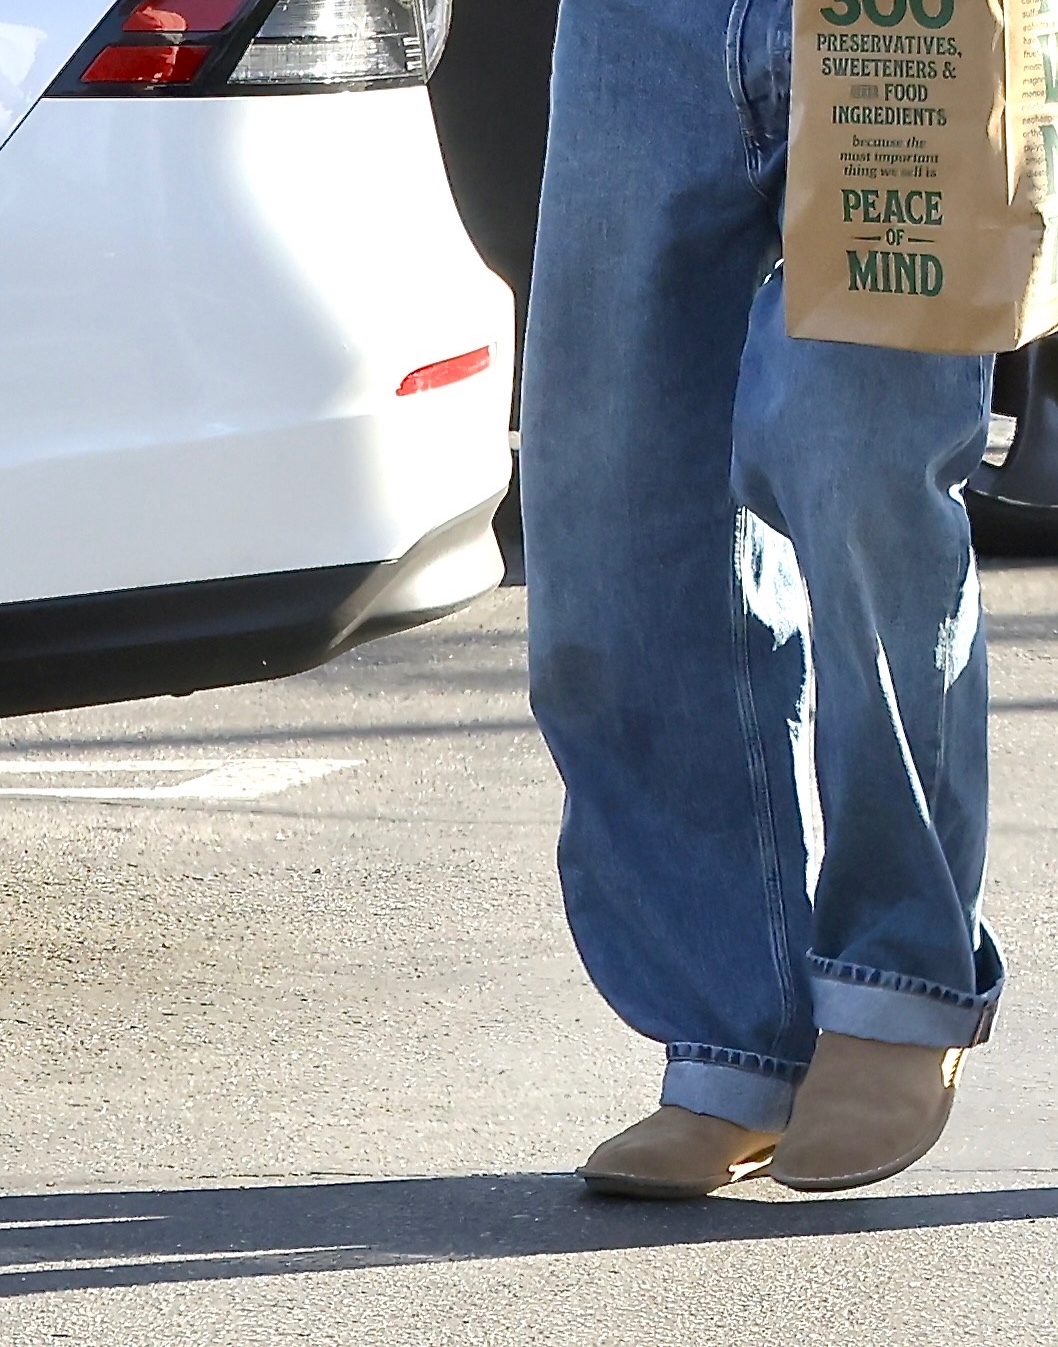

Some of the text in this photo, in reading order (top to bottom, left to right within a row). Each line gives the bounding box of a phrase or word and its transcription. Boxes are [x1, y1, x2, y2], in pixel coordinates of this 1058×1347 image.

[816, 33, 962, 59] PRESERVATIVES,
[822, 57, 957, 80] SWEETENERS &
[884, 83, 928, 103] FOOD
[832, 105, 947, 127] INGREDIENTS
[852, 134, 926, 149] because the
[840, 152, 939, 165] most important
[843, 164, 877, 180] thing
[841, 188, 943, 226] PEACE
[886, 228, 904, 246] OF
[846, 250, 944, 297] MIND
